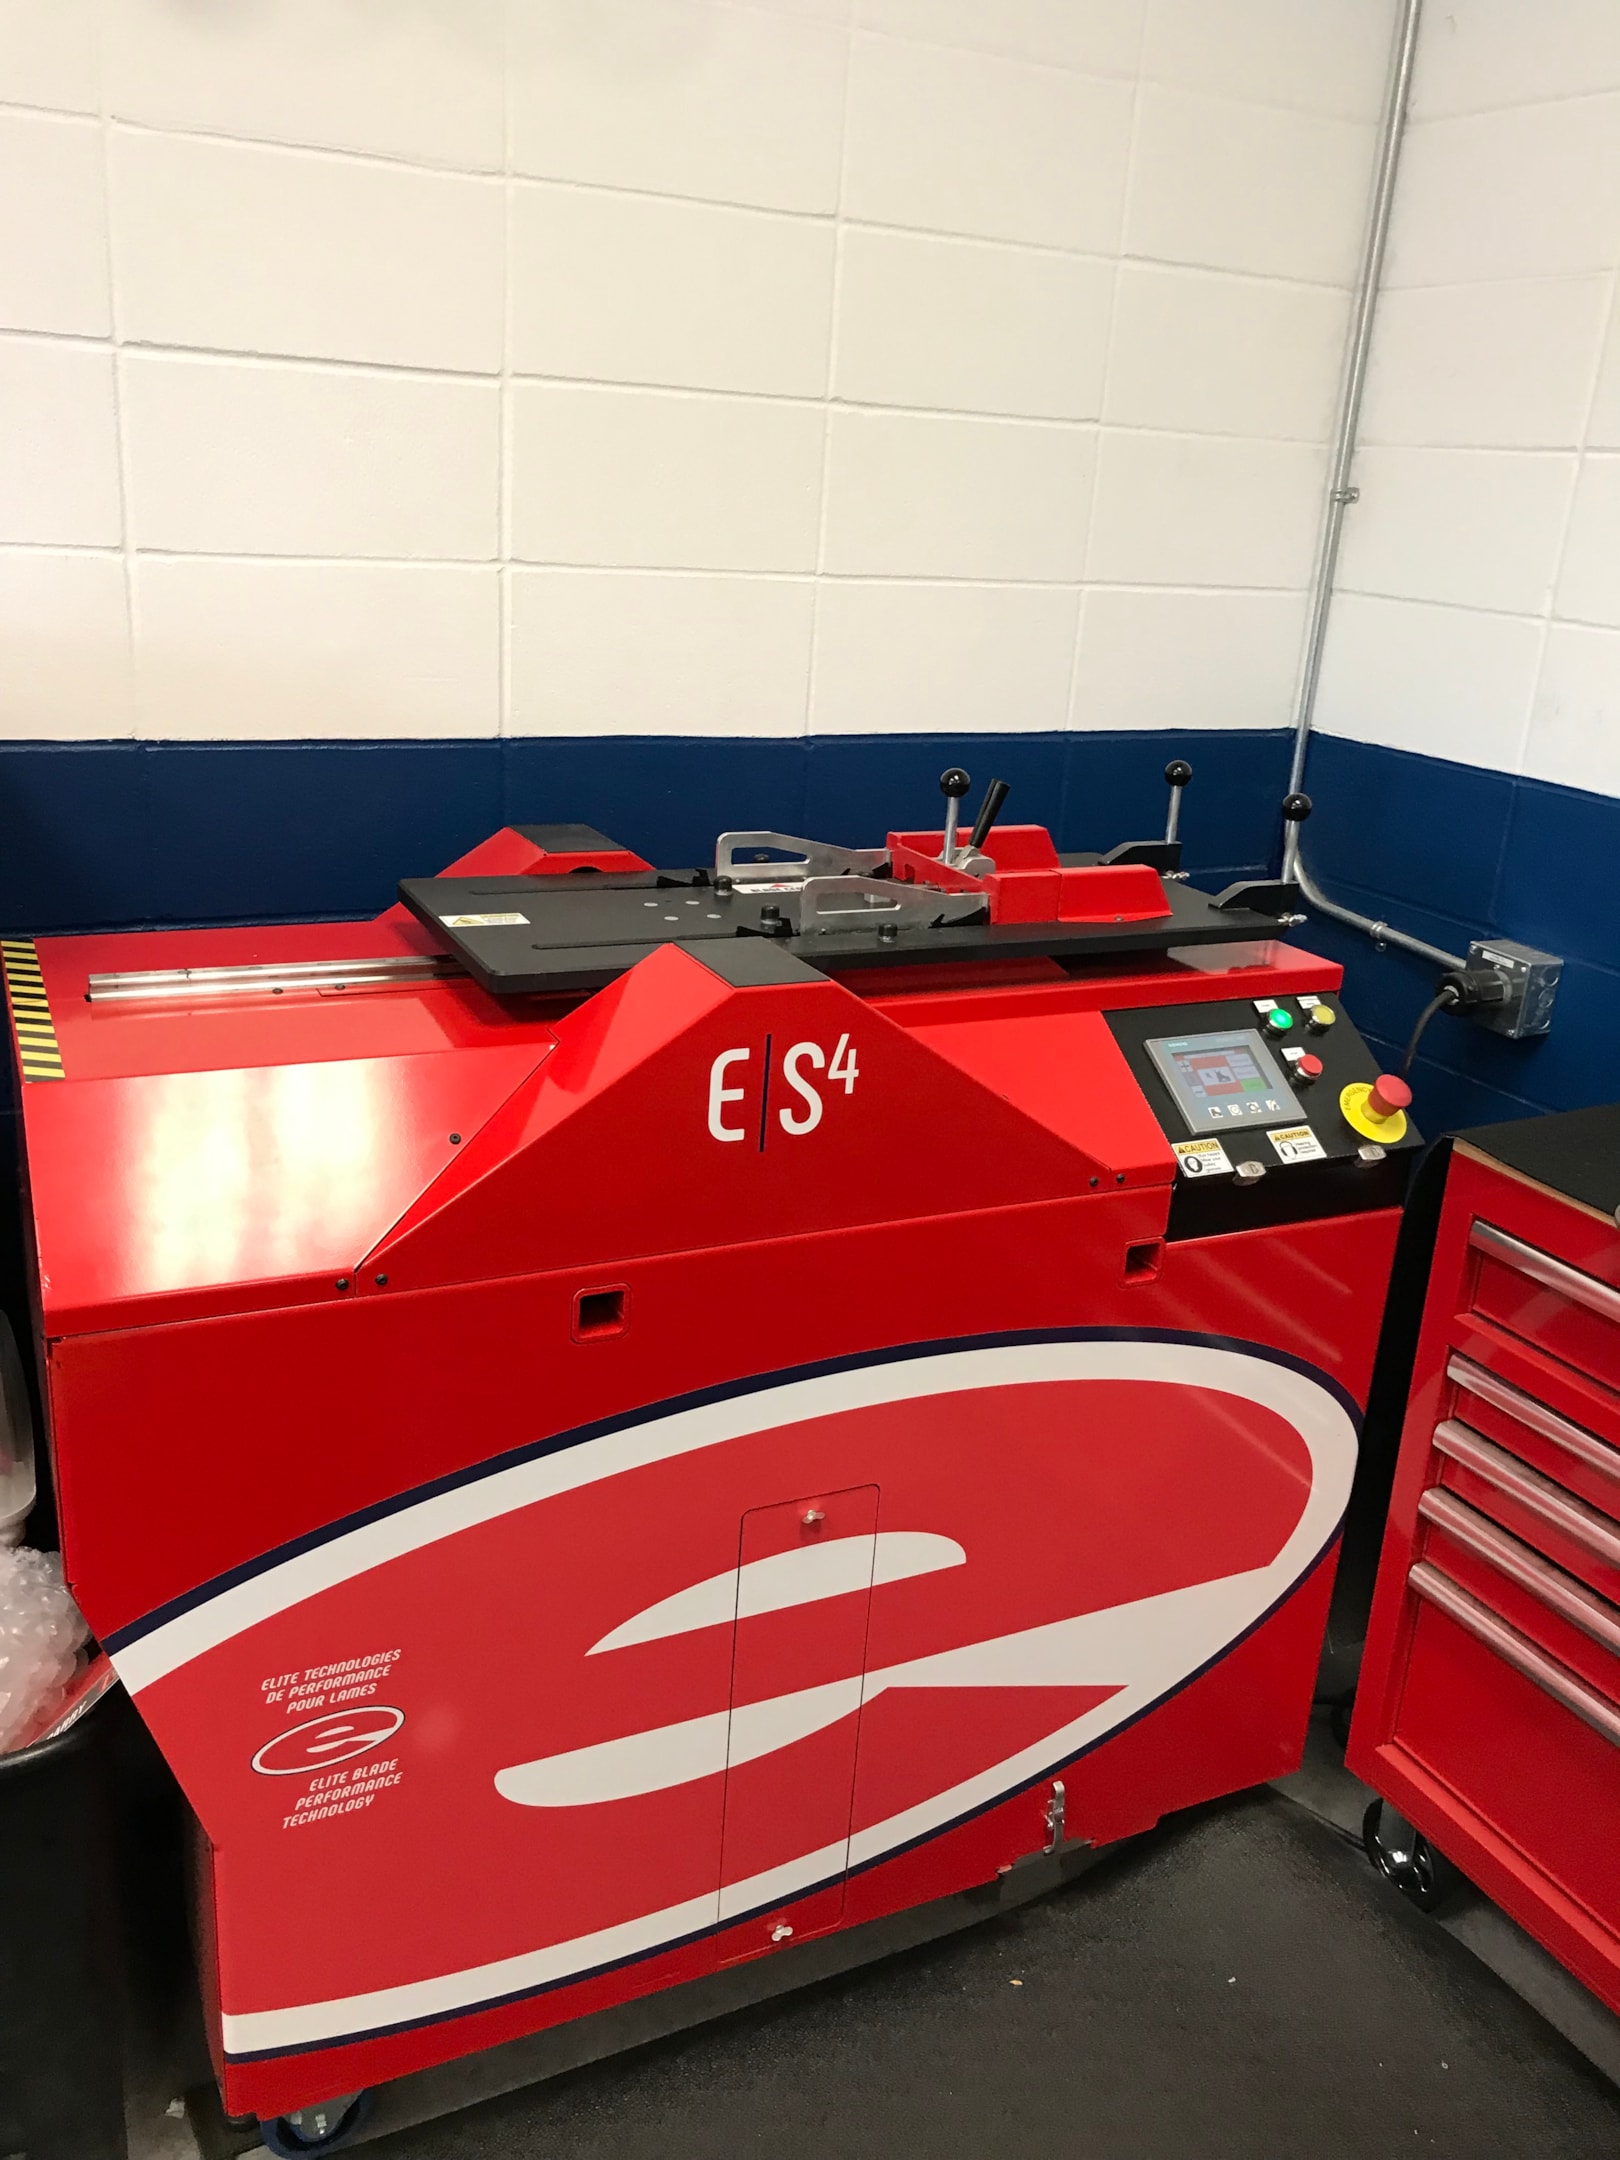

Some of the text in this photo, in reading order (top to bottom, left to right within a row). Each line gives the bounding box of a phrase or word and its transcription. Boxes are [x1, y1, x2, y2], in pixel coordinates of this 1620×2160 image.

[1184, 1141, 1219, 1153] CAUTION
[1279, 1130, 1309, 1140] CAUTION
[261, 1648, 402, 1691] ELITE TECHNOLOGIES
[265, 1664, 392, 1704] DE PERFORMANCE
[286, 1682, 378, 1714] POUR LAMES
[294, 1771, 404, 1811] PERFORMANCE
[309, 1758, 399, 1792] ELITE BLADE
[282, 1793, 375, 1830] TECHNOLOGY
